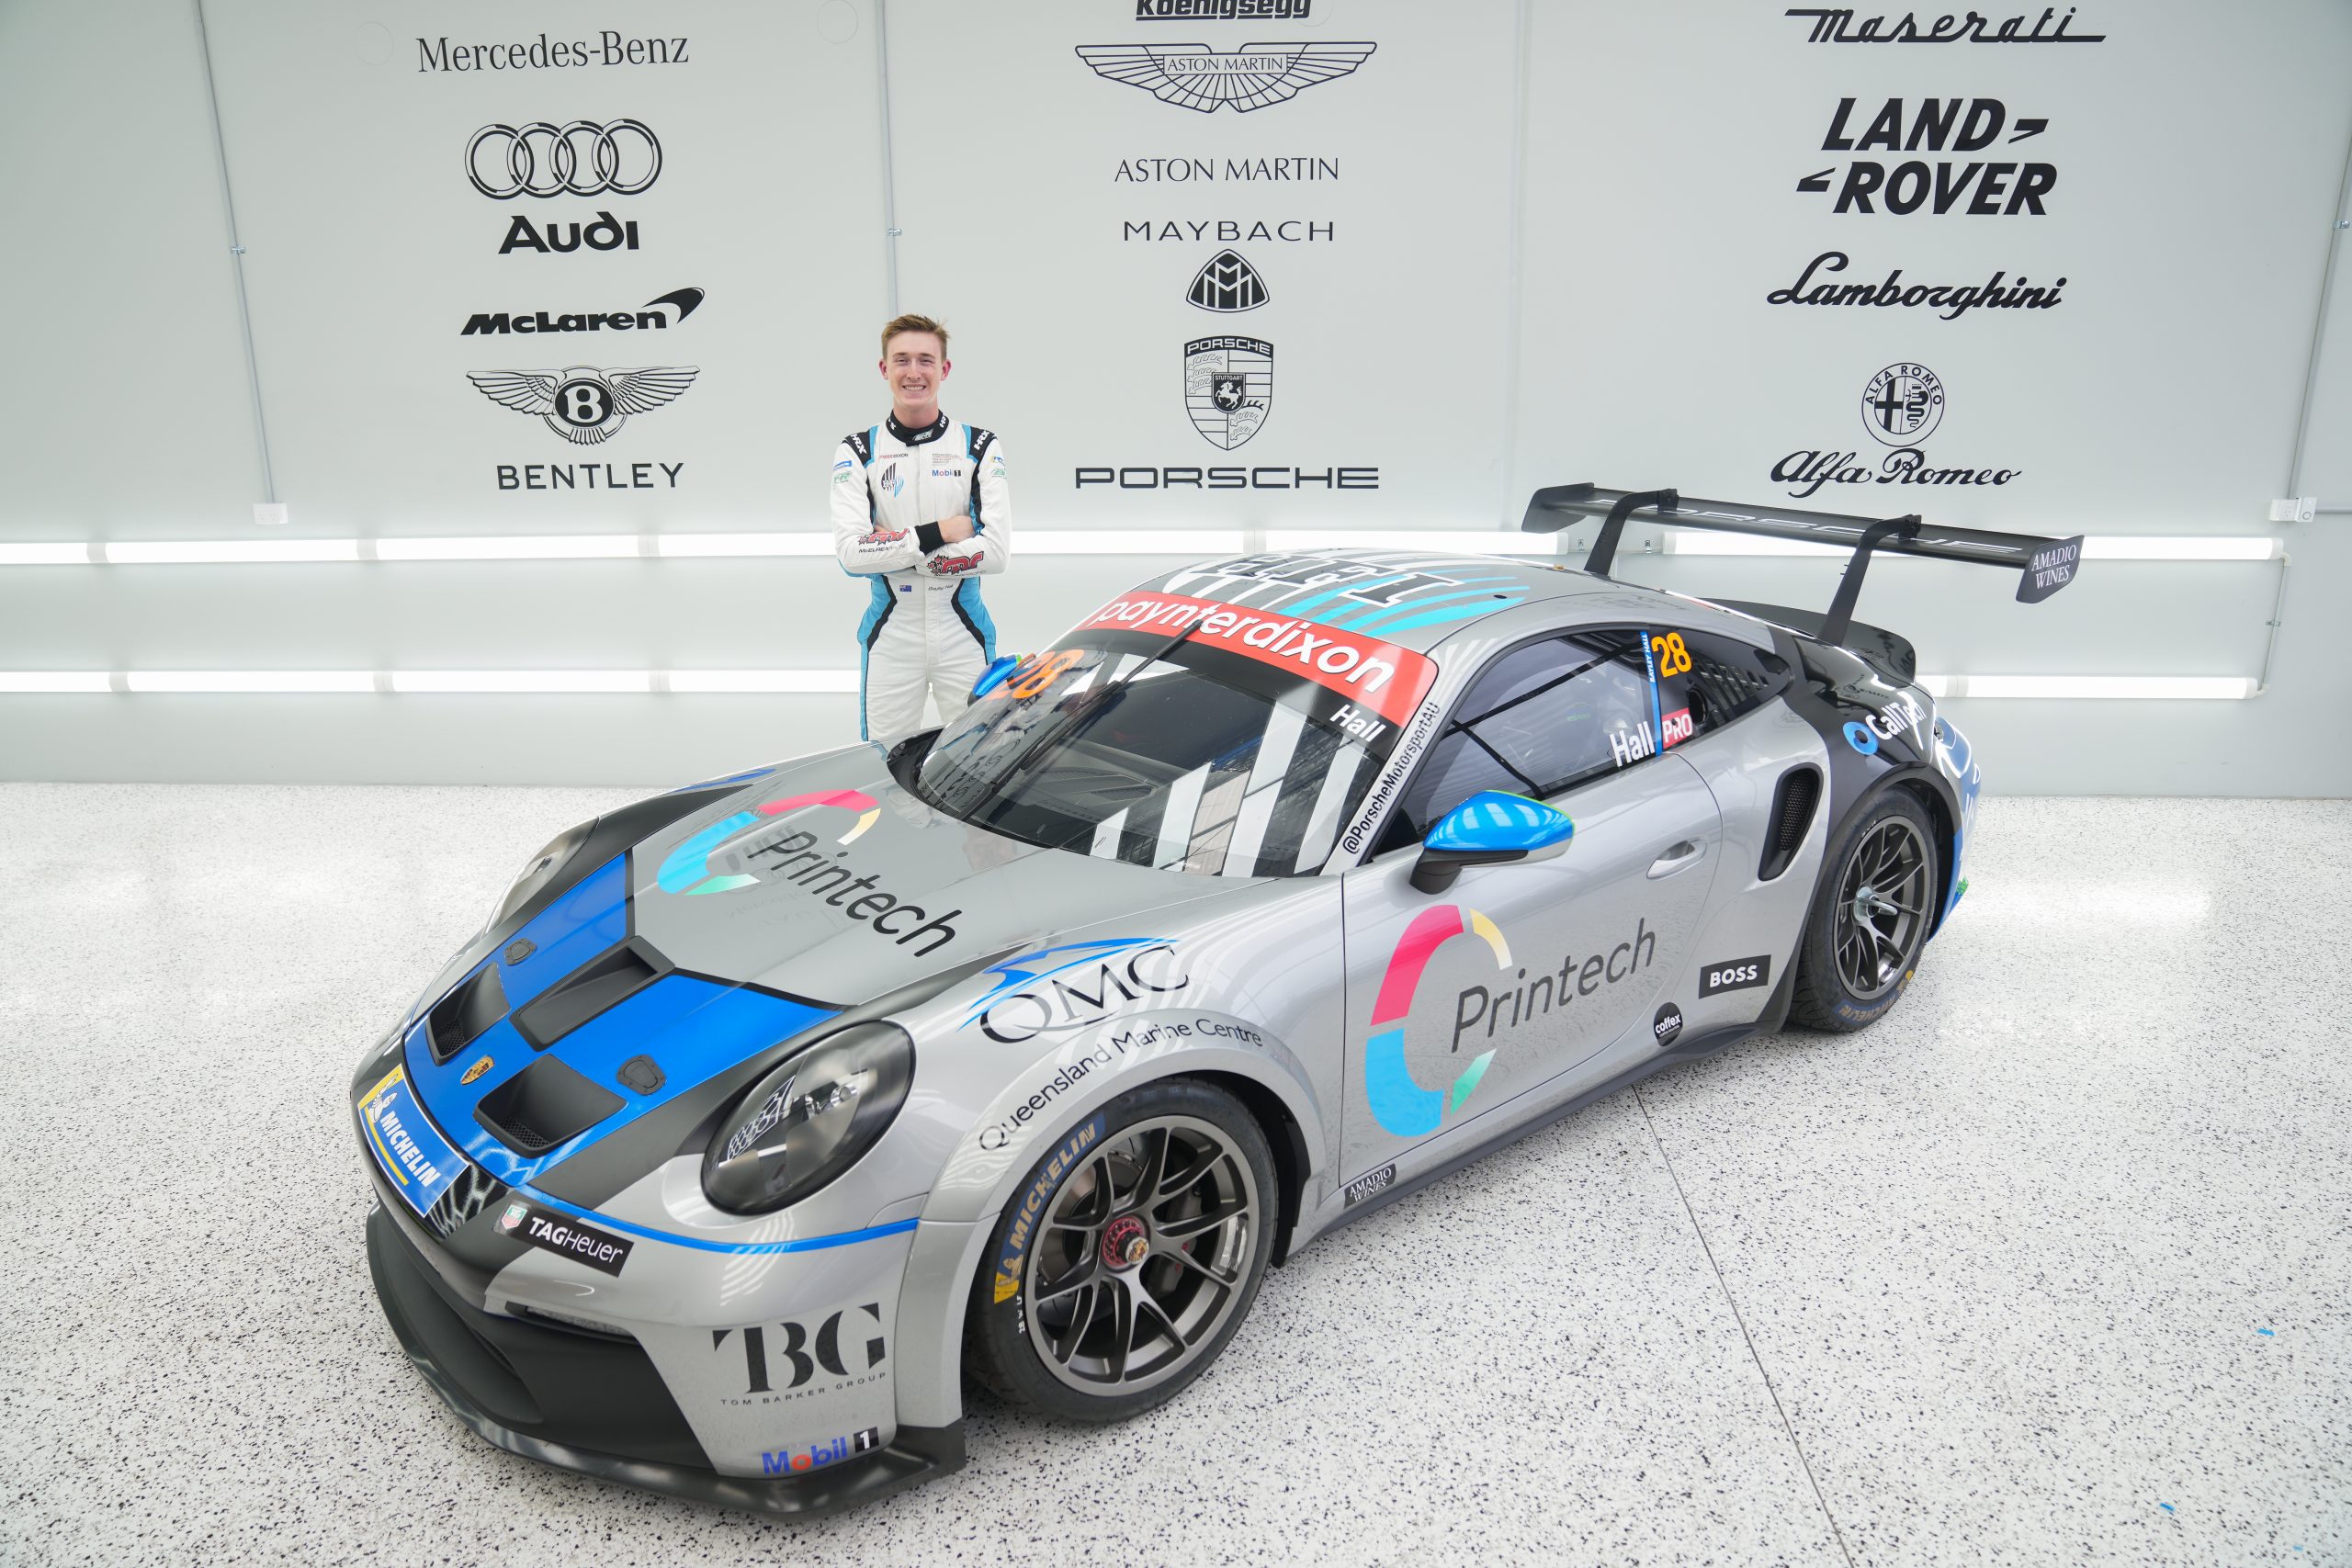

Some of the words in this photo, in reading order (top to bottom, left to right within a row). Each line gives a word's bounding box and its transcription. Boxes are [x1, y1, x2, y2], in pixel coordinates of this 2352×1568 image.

[1784, 6, 2107, 43] Maserati
[415, 30, 689, 73] Mercedes-Benz
[1168, 58, 1218, 72] ASTON
[1224, 57, 1283, 71] MARTIN
[1821, 97, 2006, 152] LAND
[1114, 158, 1214, 183] ASTON
[1225, 157, 1339, 182] MARTIN
[1832, 160, 2058, 216] ROVER
[497, 210, 640, 255] Audi
[1124, 220, 1334, 242] MAYBACH
[1766, 251, 2068, 321] Lamborghini
[460, 305, 671, 336] McLaren
[1187, 338, 1271, 355] PORSCHE
[563, 384, 606, 423] B
[1864, 370, 1894, 405] ALFA
[1900, 365, 1943, 405] ROMEO
[496, 462, 684, 491] BENTLEY
[1075, 467, 1380, 490] PORSCHE
[1770, 450, 1872, 499] Alfa
[1872, 447, 2022, 486] Romeo
[2030, 544, 2077, 572] AMADIO
[2035, 564, 2071, 590] WINES
[1097, 598, 1396, 694] paynterdixon
[1650, 631, 1692, 678] 28
[1329, 704, 1386, 745] Hall
[1610, 721, 1657, 768] Hall
[1661, 713, 1693, 744] PRO
[1342, 701, 1442, 855] @PorscheMotorsportAU
[747, 830, 964, 958] Printech
[1451, 917, 1657, 1055] Printech
[1708, 964, 1758, 989] BOSS
[978, 1043, 1112, 1153] Queensland
[1112, 1021, 1193, 1055] Marine
[1194, 1018, 1264, 1049] Centre
[379, 1111, 442, 1189] MICHELIN
[1009, 1122, 1096, 1251] MICHELIN
[1349, 1167, 1392, 1198] AMADIO
[711, 1302, 886, 1394] TBG
[720, 1398, 752, 1406] TOM
[763, 1386, 826, 1404] BARKER
[835, 1371, 887, 1391] GROUP
[761, 1437, 848, 1476] Mobil
